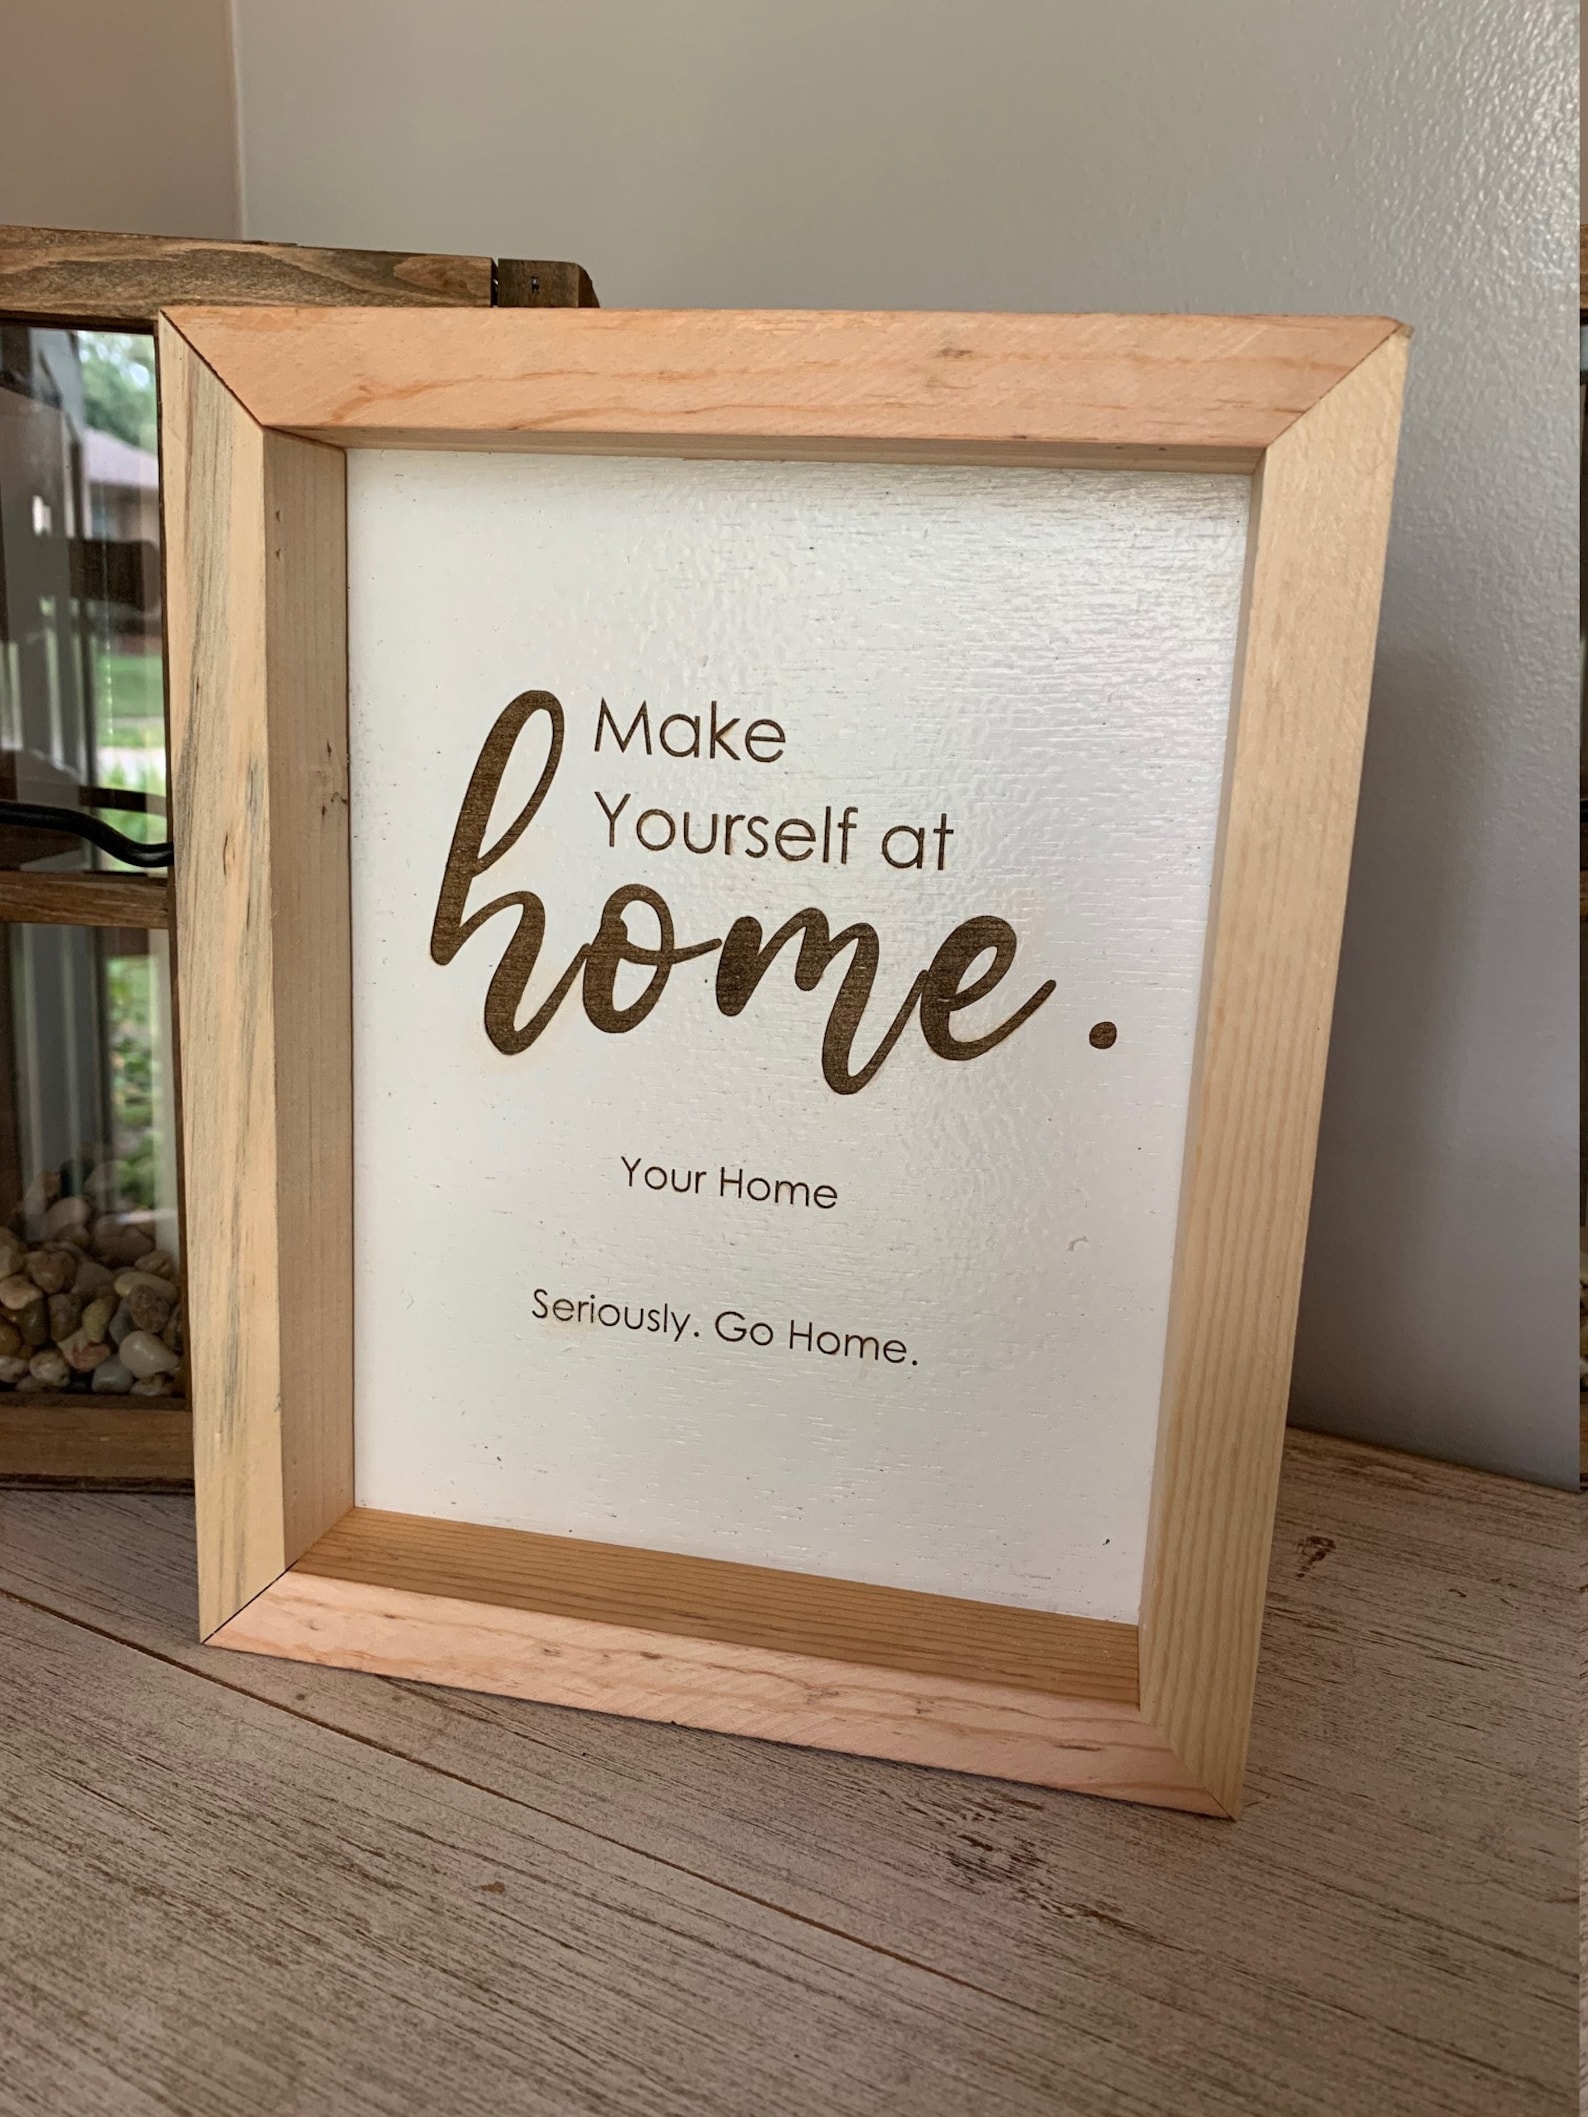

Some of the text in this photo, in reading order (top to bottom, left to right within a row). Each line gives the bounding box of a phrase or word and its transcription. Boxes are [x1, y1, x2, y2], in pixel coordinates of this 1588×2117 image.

[593, 696, 787, 764] Make
[593, 790, 955, 872] Yourself at
[621, 1155, 839, 1210] Your Home
[531, 1288, 918, 1366] Seriously. Go Home.
